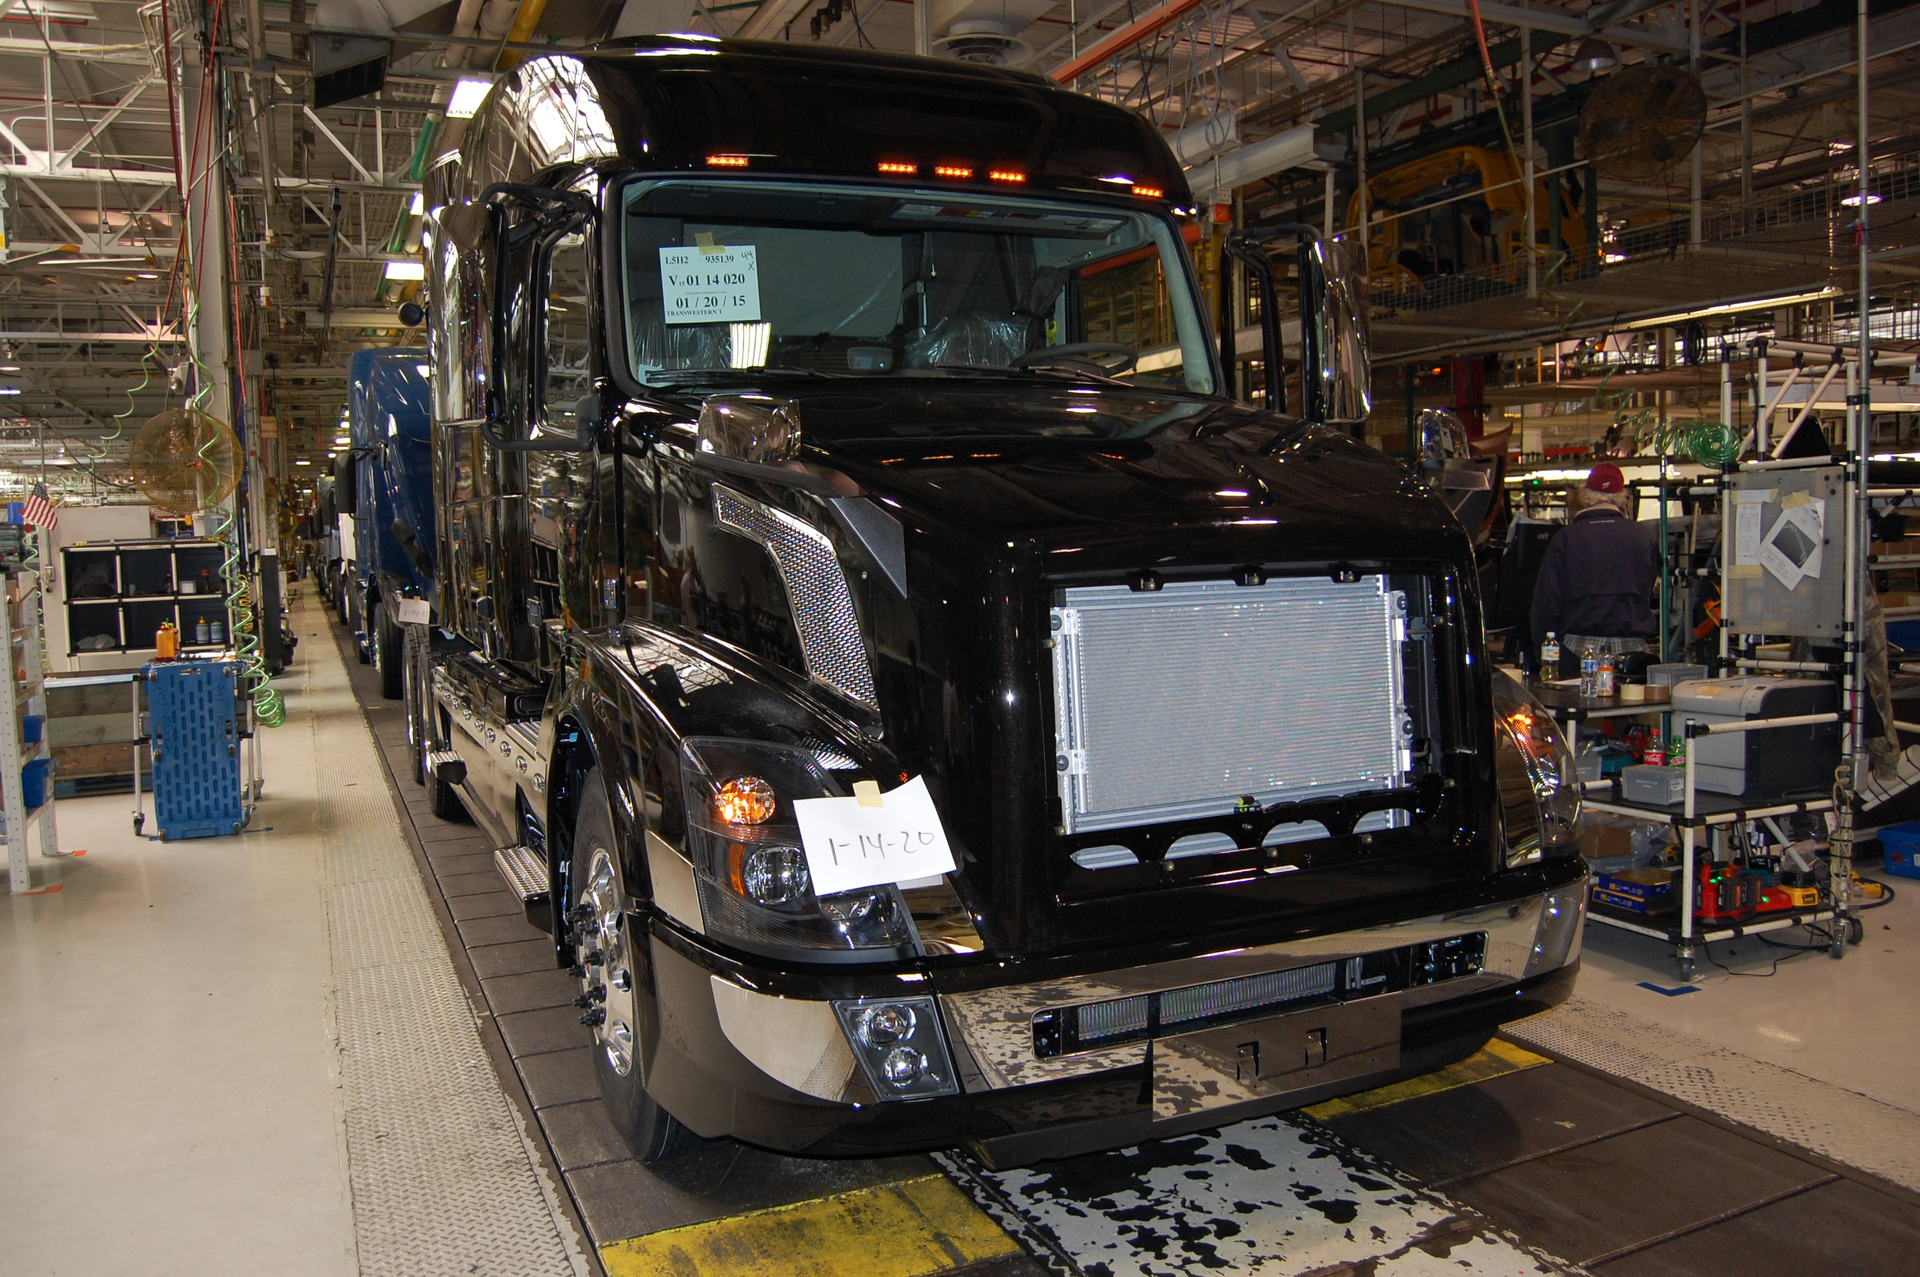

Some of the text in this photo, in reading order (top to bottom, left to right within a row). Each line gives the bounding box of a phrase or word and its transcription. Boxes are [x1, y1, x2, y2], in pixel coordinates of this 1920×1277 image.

[665, 255, 734, 264] L5H2 935139
[741, 250, 754, 260] 44
[706, 273, 720, 285] 14
[723, 273, 745, 285] 020
[828, 831, 935, 866] 1-14-20
